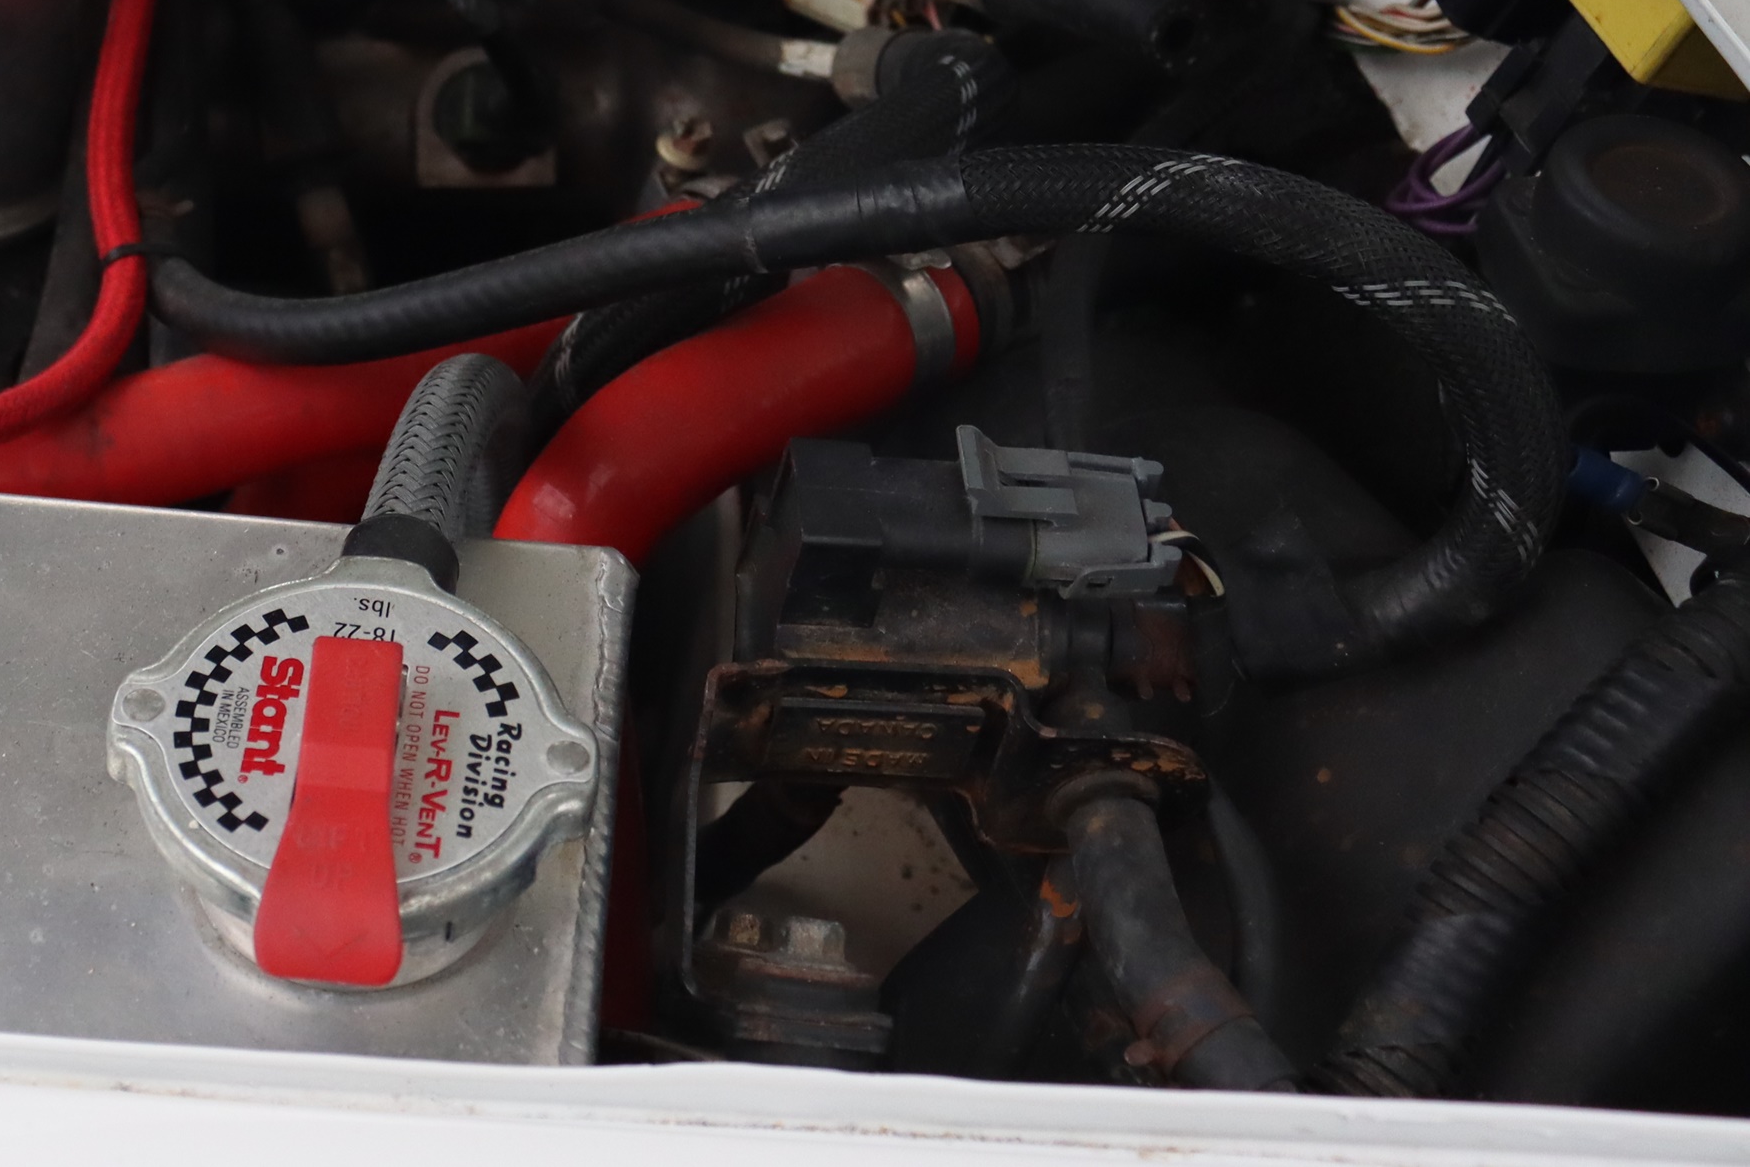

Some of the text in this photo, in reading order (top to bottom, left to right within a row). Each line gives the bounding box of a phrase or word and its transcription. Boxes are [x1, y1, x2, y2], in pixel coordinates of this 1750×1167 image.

[354, 597, 391, 618] lbs.
[212, 689, 235, 743] IN MEXICO
[226, 686, 250, 749] ASSEMBLED
[391, 665, 430, 847] DO NOT OPEN WHEN HOT
[456, 734, 492, 839] Division
[483, 722, 522, 809] Racing
